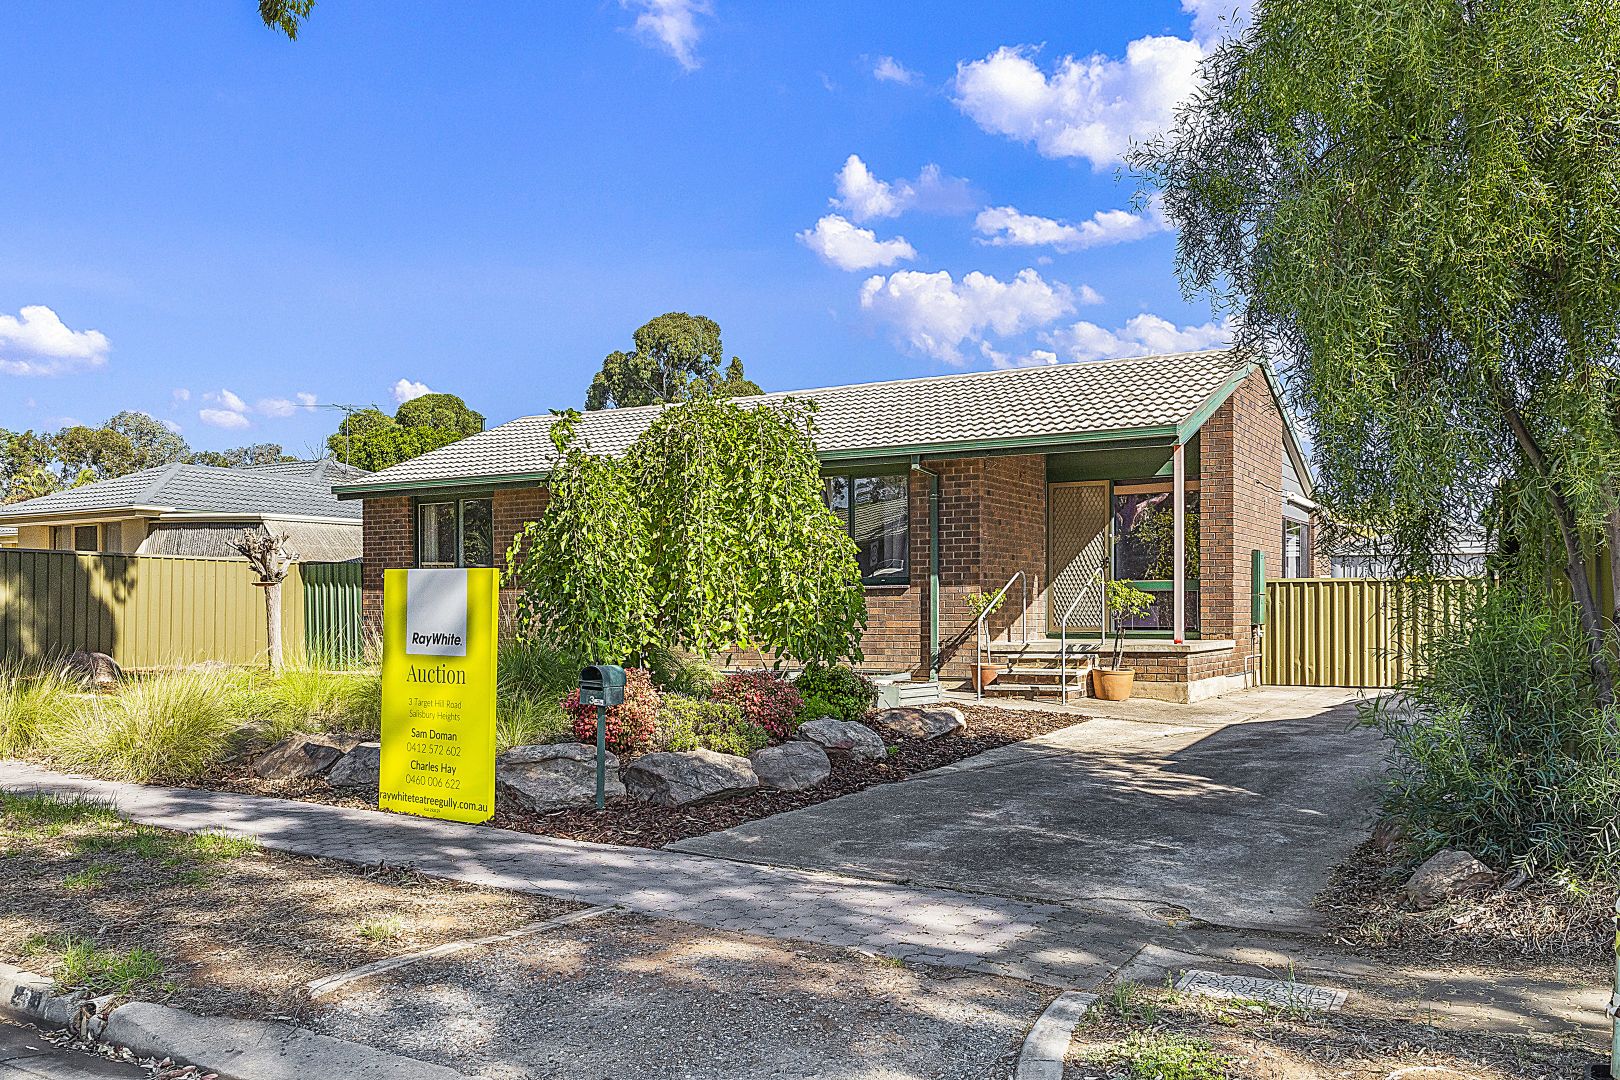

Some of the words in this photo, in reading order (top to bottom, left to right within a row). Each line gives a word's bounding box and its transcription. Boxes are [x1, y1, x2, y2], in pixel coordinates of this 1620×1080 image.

[406, 664, 466, 684] Auction
[408, 698, 413, 706] 3
[414, 698, 433, 709] Target
[434, 699, 445, 708] Hill
[446, 700, 462, 709] Road
[589, 696, 595, 704] 3
[409, 709, 436, 720] Salisbury
[437, 712, 461, 722] Heights
[411, 727, 428, 739] Sam
[429, 729, 458, 741] Doman
[406, 741, 427, 753] 0412
[428, 743, 444, 756] 572
[445, 746, 461, 757] 602
[410, 759, 439, 772] Charles
[440, 763, 457, 775] Hay
[405, 773, 426, 786] 0460
[427, 776, 443, 788] 006
[444, 778, 461, 790] 622
[379, 790, 488, 813] raywhiteteatreegully.com.au
